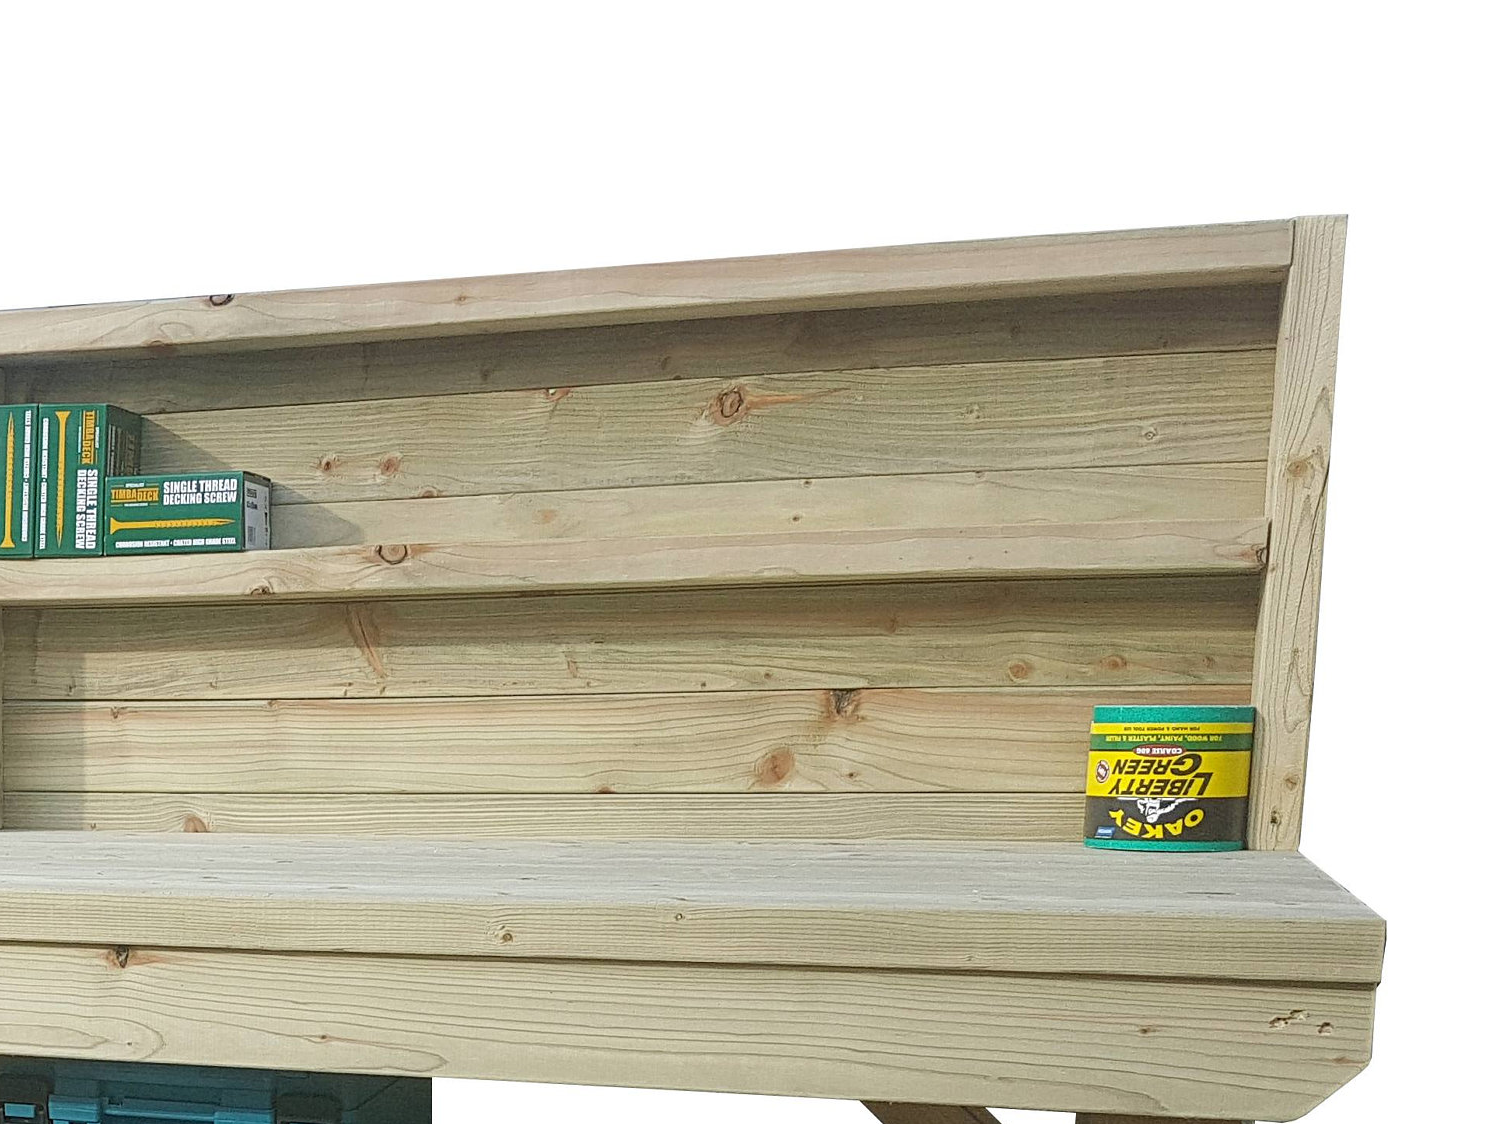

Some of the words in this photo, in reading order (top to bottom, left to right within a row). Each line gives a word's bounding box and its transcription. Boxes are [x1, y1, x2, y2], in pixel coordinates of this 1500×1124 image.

[76, 469, 87, 513] DECKING
[86, 469, 98, 508] SINGLE
[163, 480, 197, 494] SINGLE
[199, 479, 238, 493] THREAD
[163, 492, 203, 505] DECKING
[204, 491, 237, 503] SCREW
[75, 514, 86, 549] SCREW
[86, 508, 97, 549] THREAD
[1112, 753, 1202, 776] GREEN
[1108, 772, 1213, 796] LIBERTY
[1109, 808, 1204, 838] OAKEY
